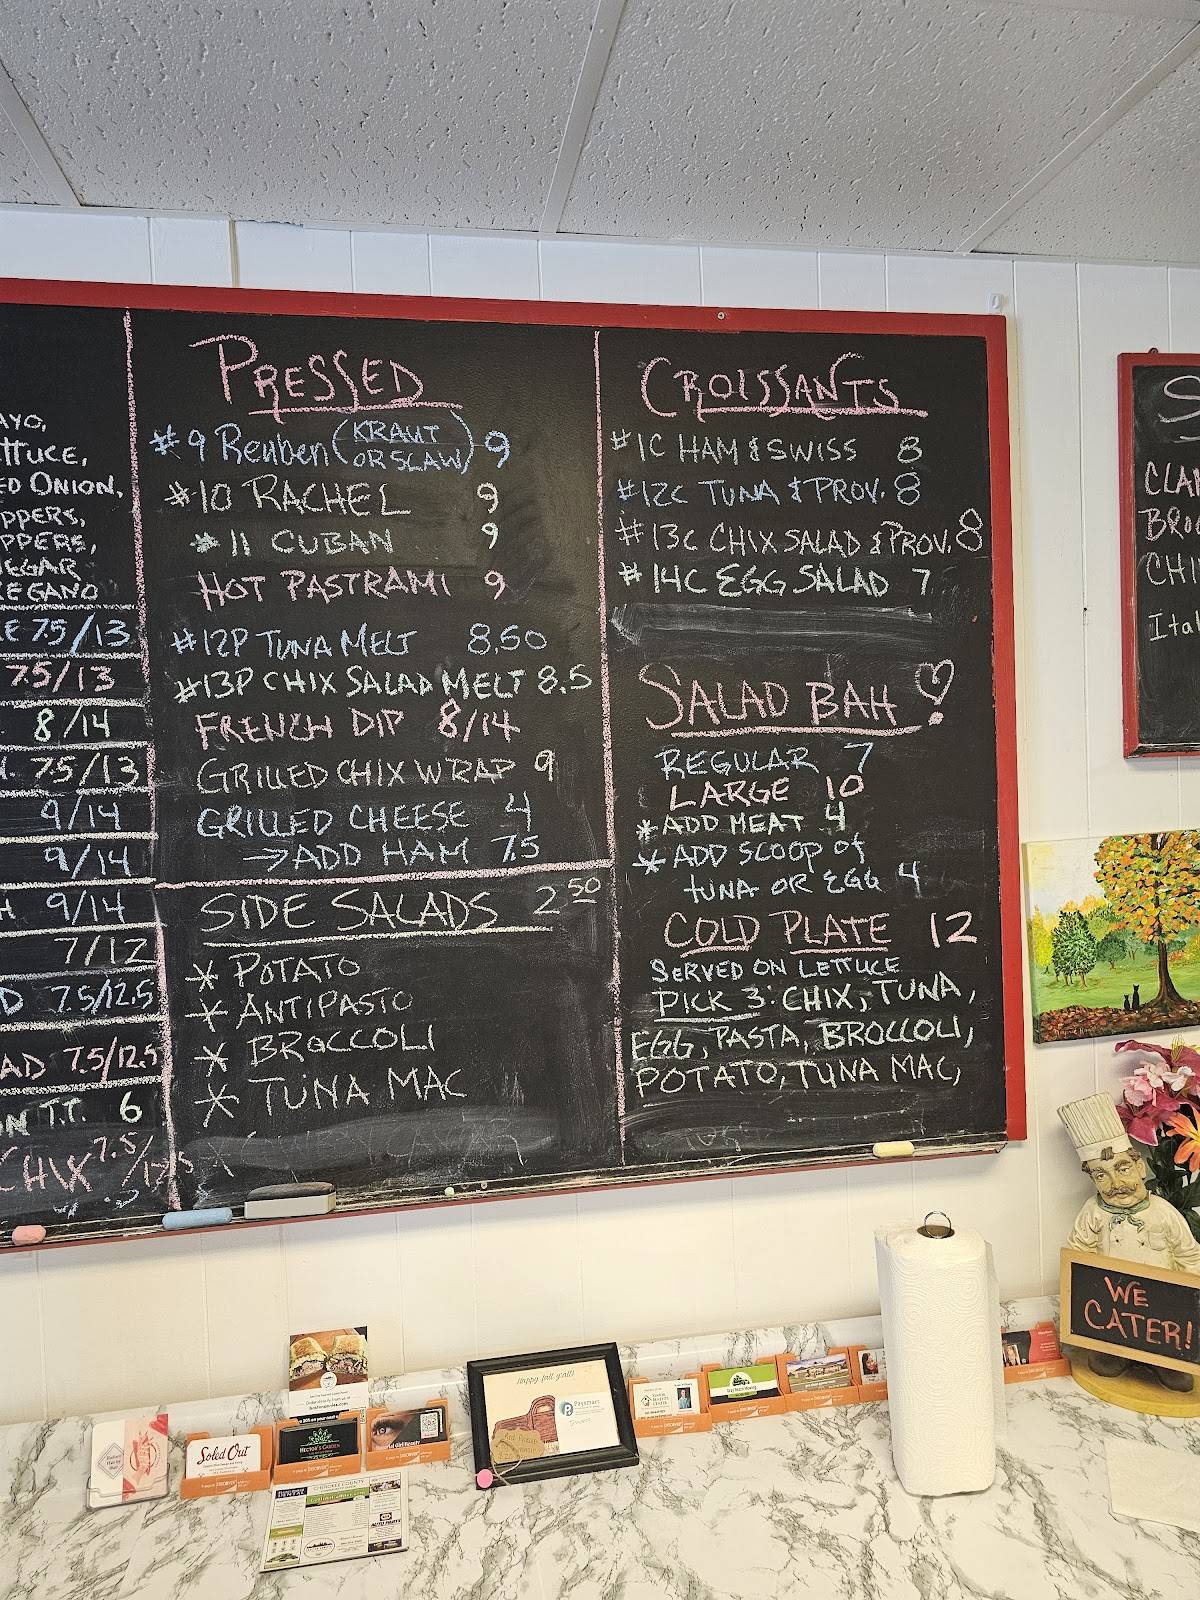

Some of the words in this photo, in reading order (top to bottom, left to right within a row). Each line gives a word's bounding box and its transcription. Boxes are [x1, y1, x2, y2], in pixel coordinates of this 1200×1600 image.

[188, 333, 424, 420] PRESSED
[640, 352, 900, 421] CROISSANTS
[215, 422, 329, 467] Reuben
[484, 430, 510, 468] 9
[678, 433, 739, 466] HAM
[766, 438, 857, 463] SWISS
[897, 436, 923, 463] 8
[29, 471, 124, 498] ONION,
[242, 474, 411, 516] RACHEL
[476, 482, 499, 514] 9
[699, 479, 781, 507] TUNA
[894, 471, 921, 506] 8
[271, 529, 393, 555] CUBAN
[481, 522, 499, 549] 9
[709, 523, 776, 553] CHIX
[784, 531, 861, 557] SALAD
[955, 508, 983, 551] 8
[0, 557, 81, 581] EGAR
[715, 563, 788, 597] EGG
[792, 563, 889, 597] SALAD
[912, 568, 930, 595] 7
[1147, 552, 1200, 587] CHI
[0, 582, 98, 602] EGANO
[198, 571, 265, 611] HOT
[280, 566, 452, 604] PASTRAMI
[484, 570, 506, 600] 9
[256, 629, 333, 660] TUNA
[340, 622, 418, 657] MELT
[263, 669, 338, 695] CHIX
[345, 664, 433, 697] SALAD
[441, 667, 526, 700] MELT
[537, 664, 593, 695] 8.5
[639, 664, 789, 730] SALAD
[34, 704, 110, 742] 8/14
[195, 711, 333, 751] FRENCH
[348, 706, 404, 738] DIP
[437, 697, 521, 743] 8/14
[196, 758, 329, 795] GRILLED
[336, 758, 405, 787] CHIX
[414, 757, 516, 784] WRAP
[534, 749, 555, 783] 9
[655, 747, 819, 780] REGULAR
[844, 742, 873, 773] 7
[669, 777, 790, 811] LARGE
[826, 774, 864, 800] 10
[40, 796, 122, 831] 9/14
[196, 804, 334, 840] GRILLED
[350, 800, 470, 833] CHEESE
[505, 791, 531, 832] 4
[662, 814, 719, 835] ADD
[729, 813, 804, 835] MEAT
[825, 801, 846, 832] 4
[44, 843, 131, 879] 9/14
[294, 842, 362, 872] ADD
[382, 836, 469, 866] HAM
[673, 843, 727, 868] ADD
[738, 841, 823, 873] SCOOP
[770, 873, 812, 896] OR
[824, 868, 887, 895] EGG
[898, 861, 921, 897] 4
[46, 888, 125, 925] 9/14
[200, 892, 315, 932] SIDE
[330, 889, 499, 932] SALADS
[664, 912, 760, 948] COLD
[769, 910, 891, 946] PLATE
[930, 911, 978, 948] 12
[54, 935, 157, 966] 7/12
[228, 952, 361, 988] POTATO
[650, 959, 743, 983] SERVED
[753, 958, 787, 976] ON
[799, 957, 900, 978] LETTUCE
[235, 986, 414, 1030] ANTIPASTO
[652, 989, 731, 1017] PICK
[247, 1023, 434, 1067] BROCCOLI
[248, 1073, 370, 1117] TUNA
[387, 1065, 467, 1101] MAC
[787, 1060, 879, 1089] TUNA
[118, 1090, 143, 1124] 6
[1104, 1276, 1149, 1307] WE
[1084, 1299, 1194, 1351] CATER!
[228, 1443, 251, 1462] Out
